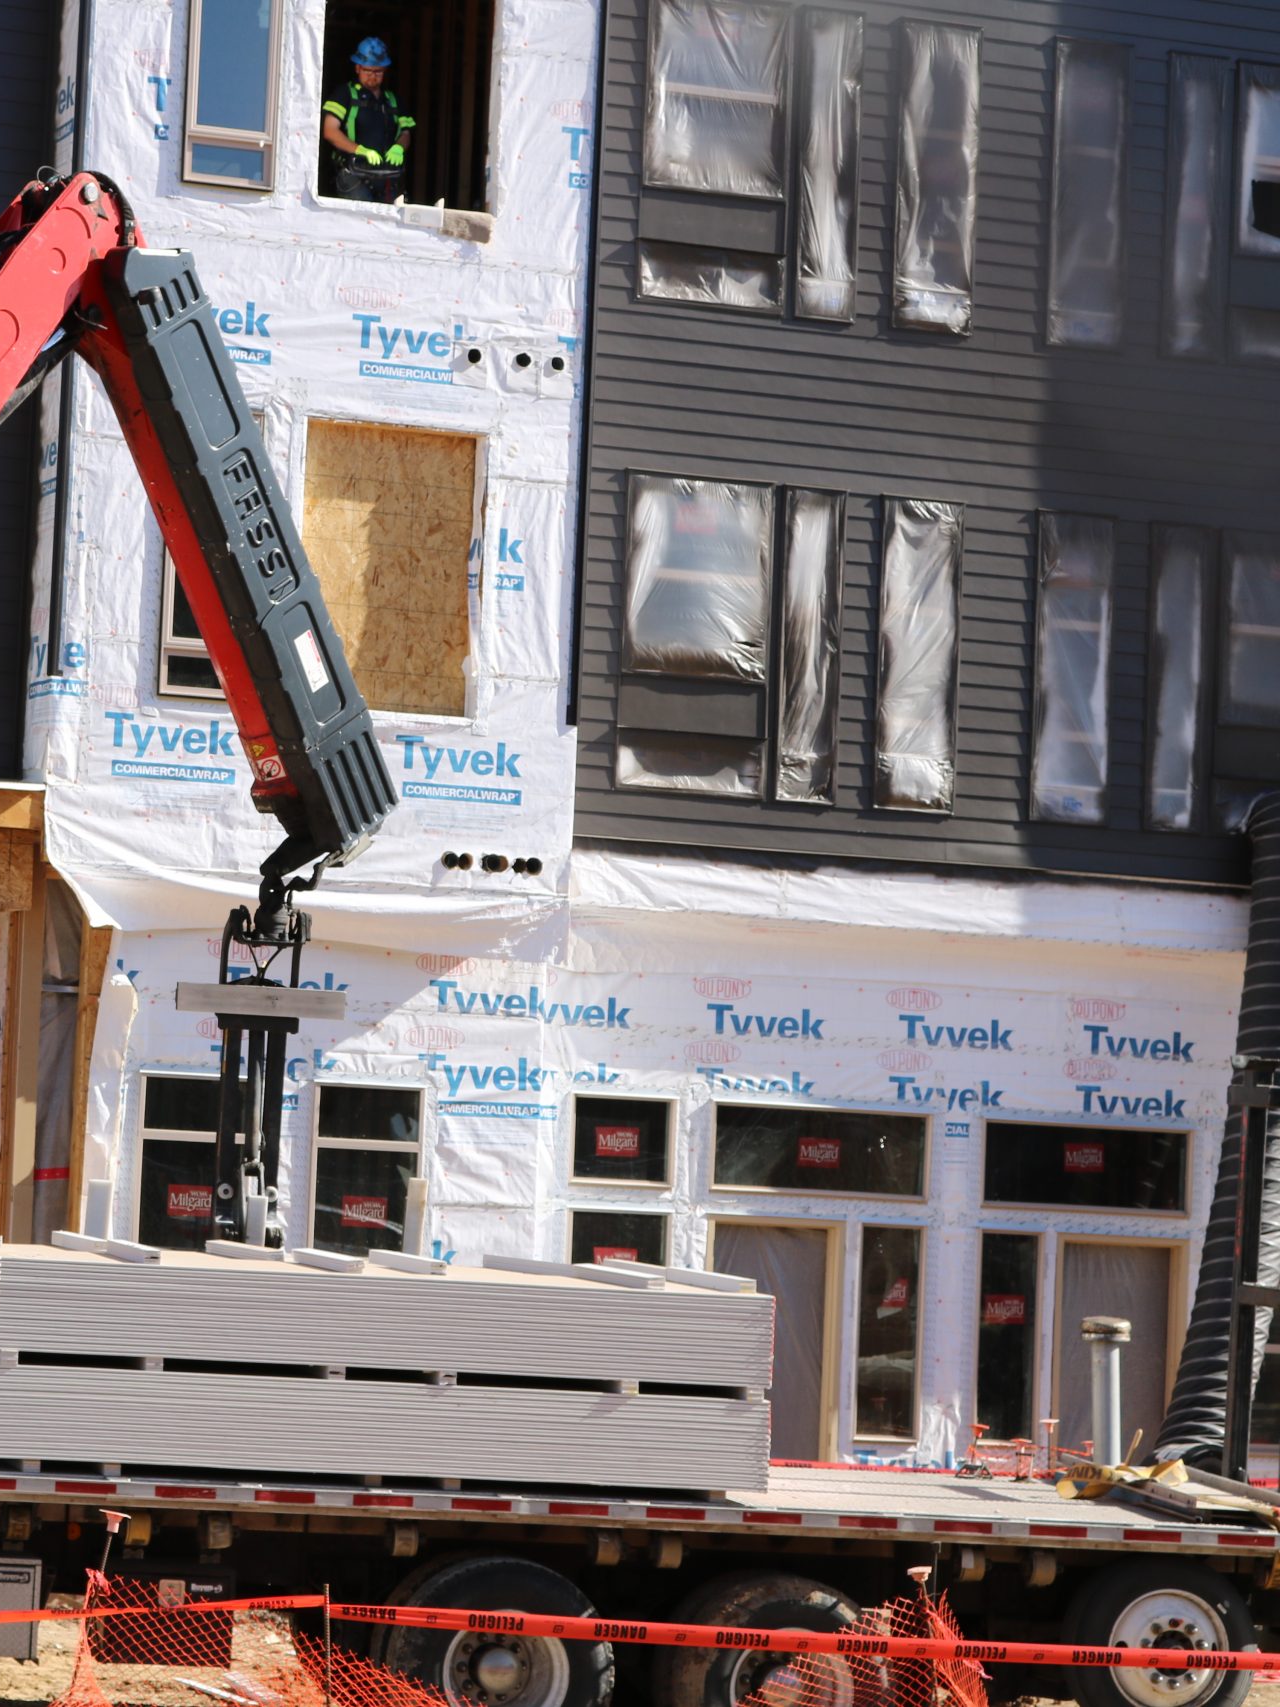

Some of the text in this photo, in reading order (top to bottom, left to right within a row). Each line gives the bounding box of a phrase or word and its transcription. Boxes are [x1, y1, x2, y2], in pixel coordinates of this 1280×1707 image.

[223, 456, 295, 596] FASSI
[105, 711, 235, 758] Tyvek
[396, 735, 522, 779] Tyvek
[114, 763, 230, 781] COMMERCIALWRAP
[405, 784, 517, 802] COMMERCIALWRAP
[599, 1133, 638, 1151] Milgard
[800, 1143, 838, 1162] Milgard
[1065, 1149, 1103, 1168] Milgard
[170, 1192, 212, 1211] Milgard
[344, 1204, 386, 1223] Milgard
[985, 1301, 1025, 1320] Milgard
[342, 1605, 1237, 1669] PELIGRO DANGER PELIGRO DANGER PELIGRO DANGER PELIGRO DANGER
